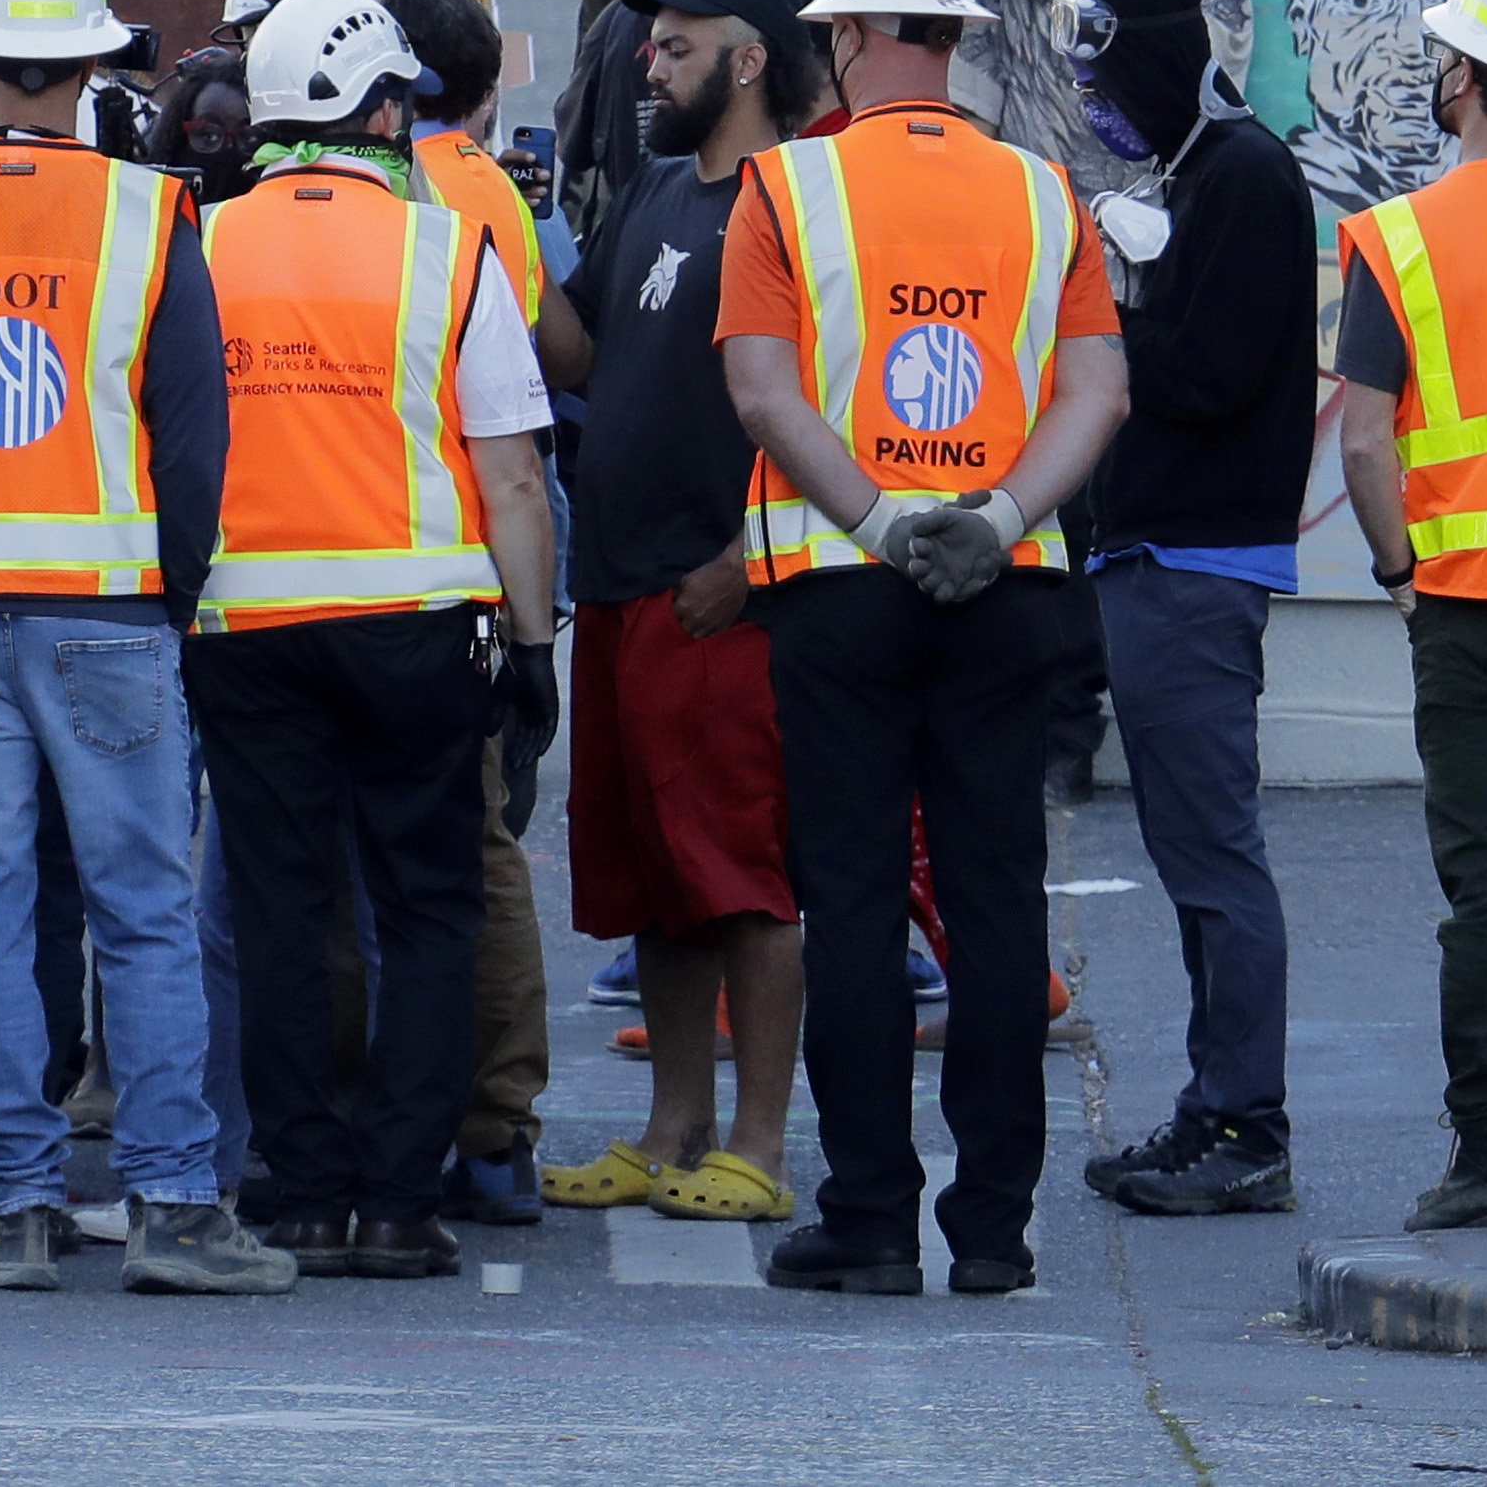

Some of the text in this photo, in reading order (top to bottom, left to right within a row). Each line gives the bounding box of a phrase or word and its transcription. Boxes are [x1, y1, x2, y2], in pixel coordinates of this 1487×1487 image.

[889, 282, 987, 321] SDOT
[263, 341, 317, 356] Seattle
[264, 357, 300, 372] Parks
[304, 358, 315, 371] &
[875, 437, 987, 469] PAVING
